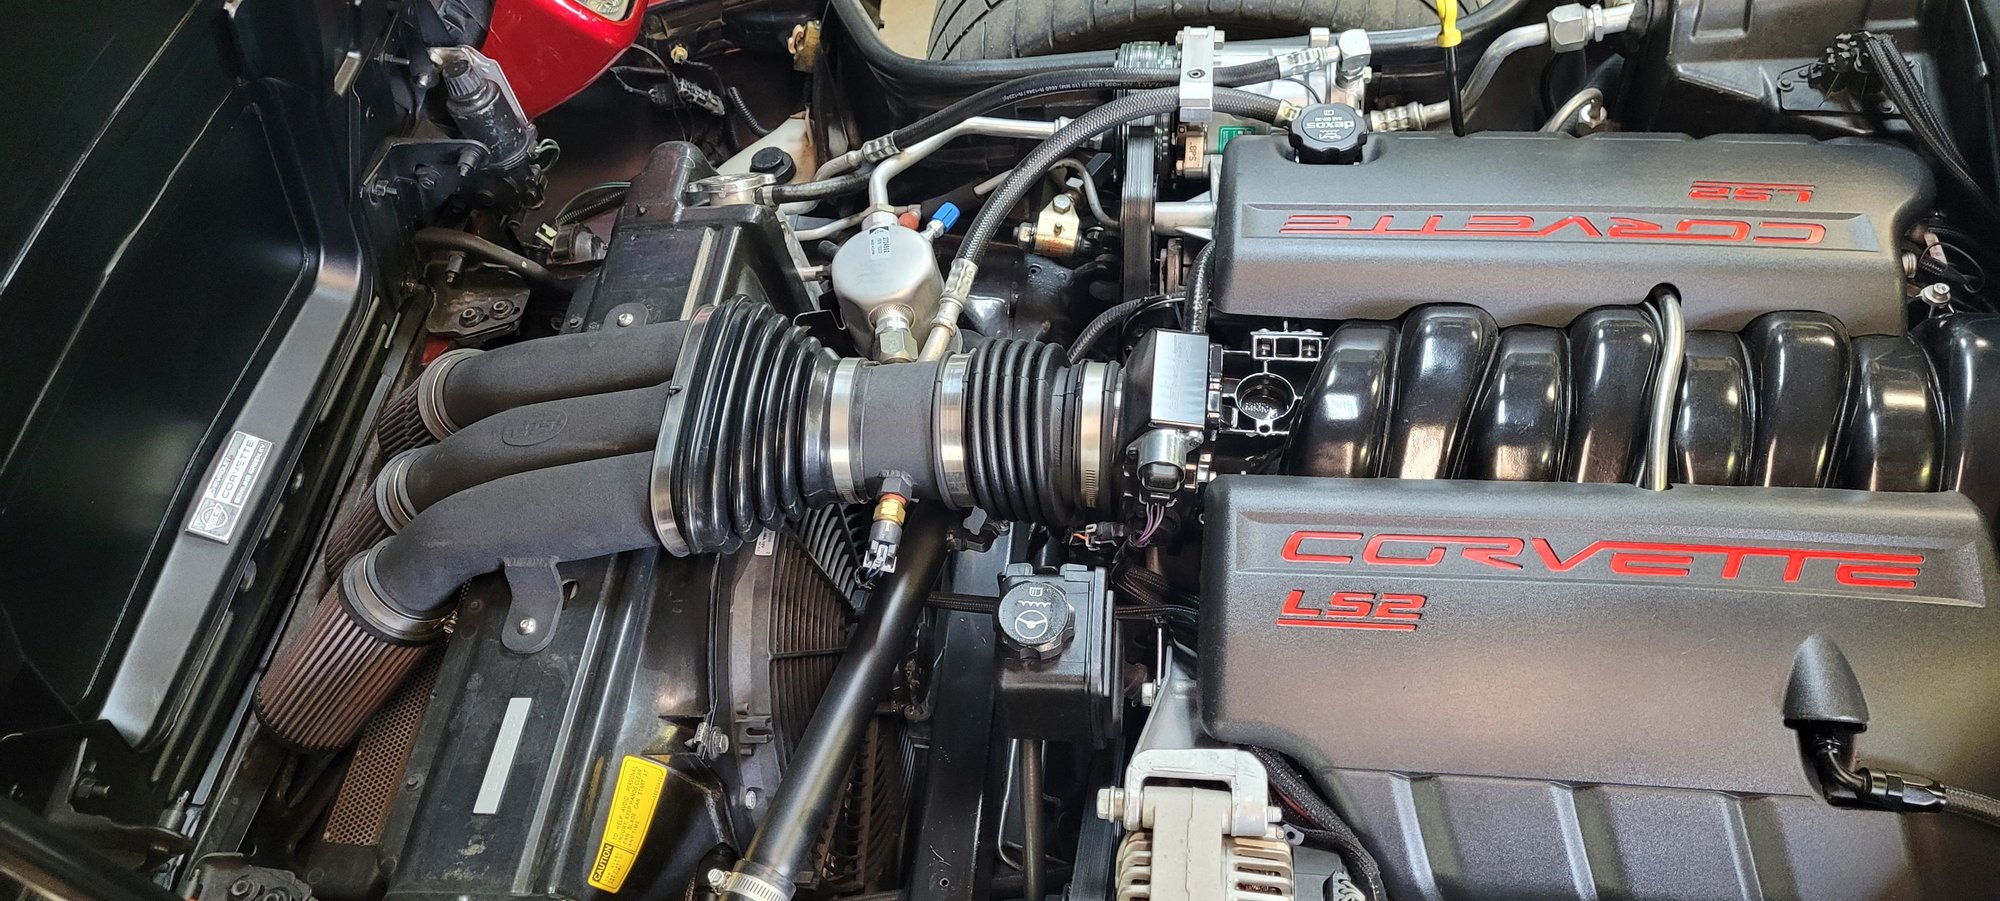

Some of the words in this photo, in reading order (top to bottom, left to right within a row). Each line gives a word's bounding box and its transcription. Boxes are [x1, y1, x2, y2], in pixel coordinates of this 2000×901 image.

[1305, 121, 1354, 129] dexos
[1689, 186, 1815, 203] LS2
[1279, 215, 1828, 243] CORVETTE
[221, 439, 254, 498] CORVETTE
[1281, 531, 1925, 589] CORVETTE
[1282, 590, 1427, 620] LS2
[621, 795, 630, 812] AVOID
[626, 766, 638, 792] PERSONAL
[593, 844, 613, 881] CAUTION
